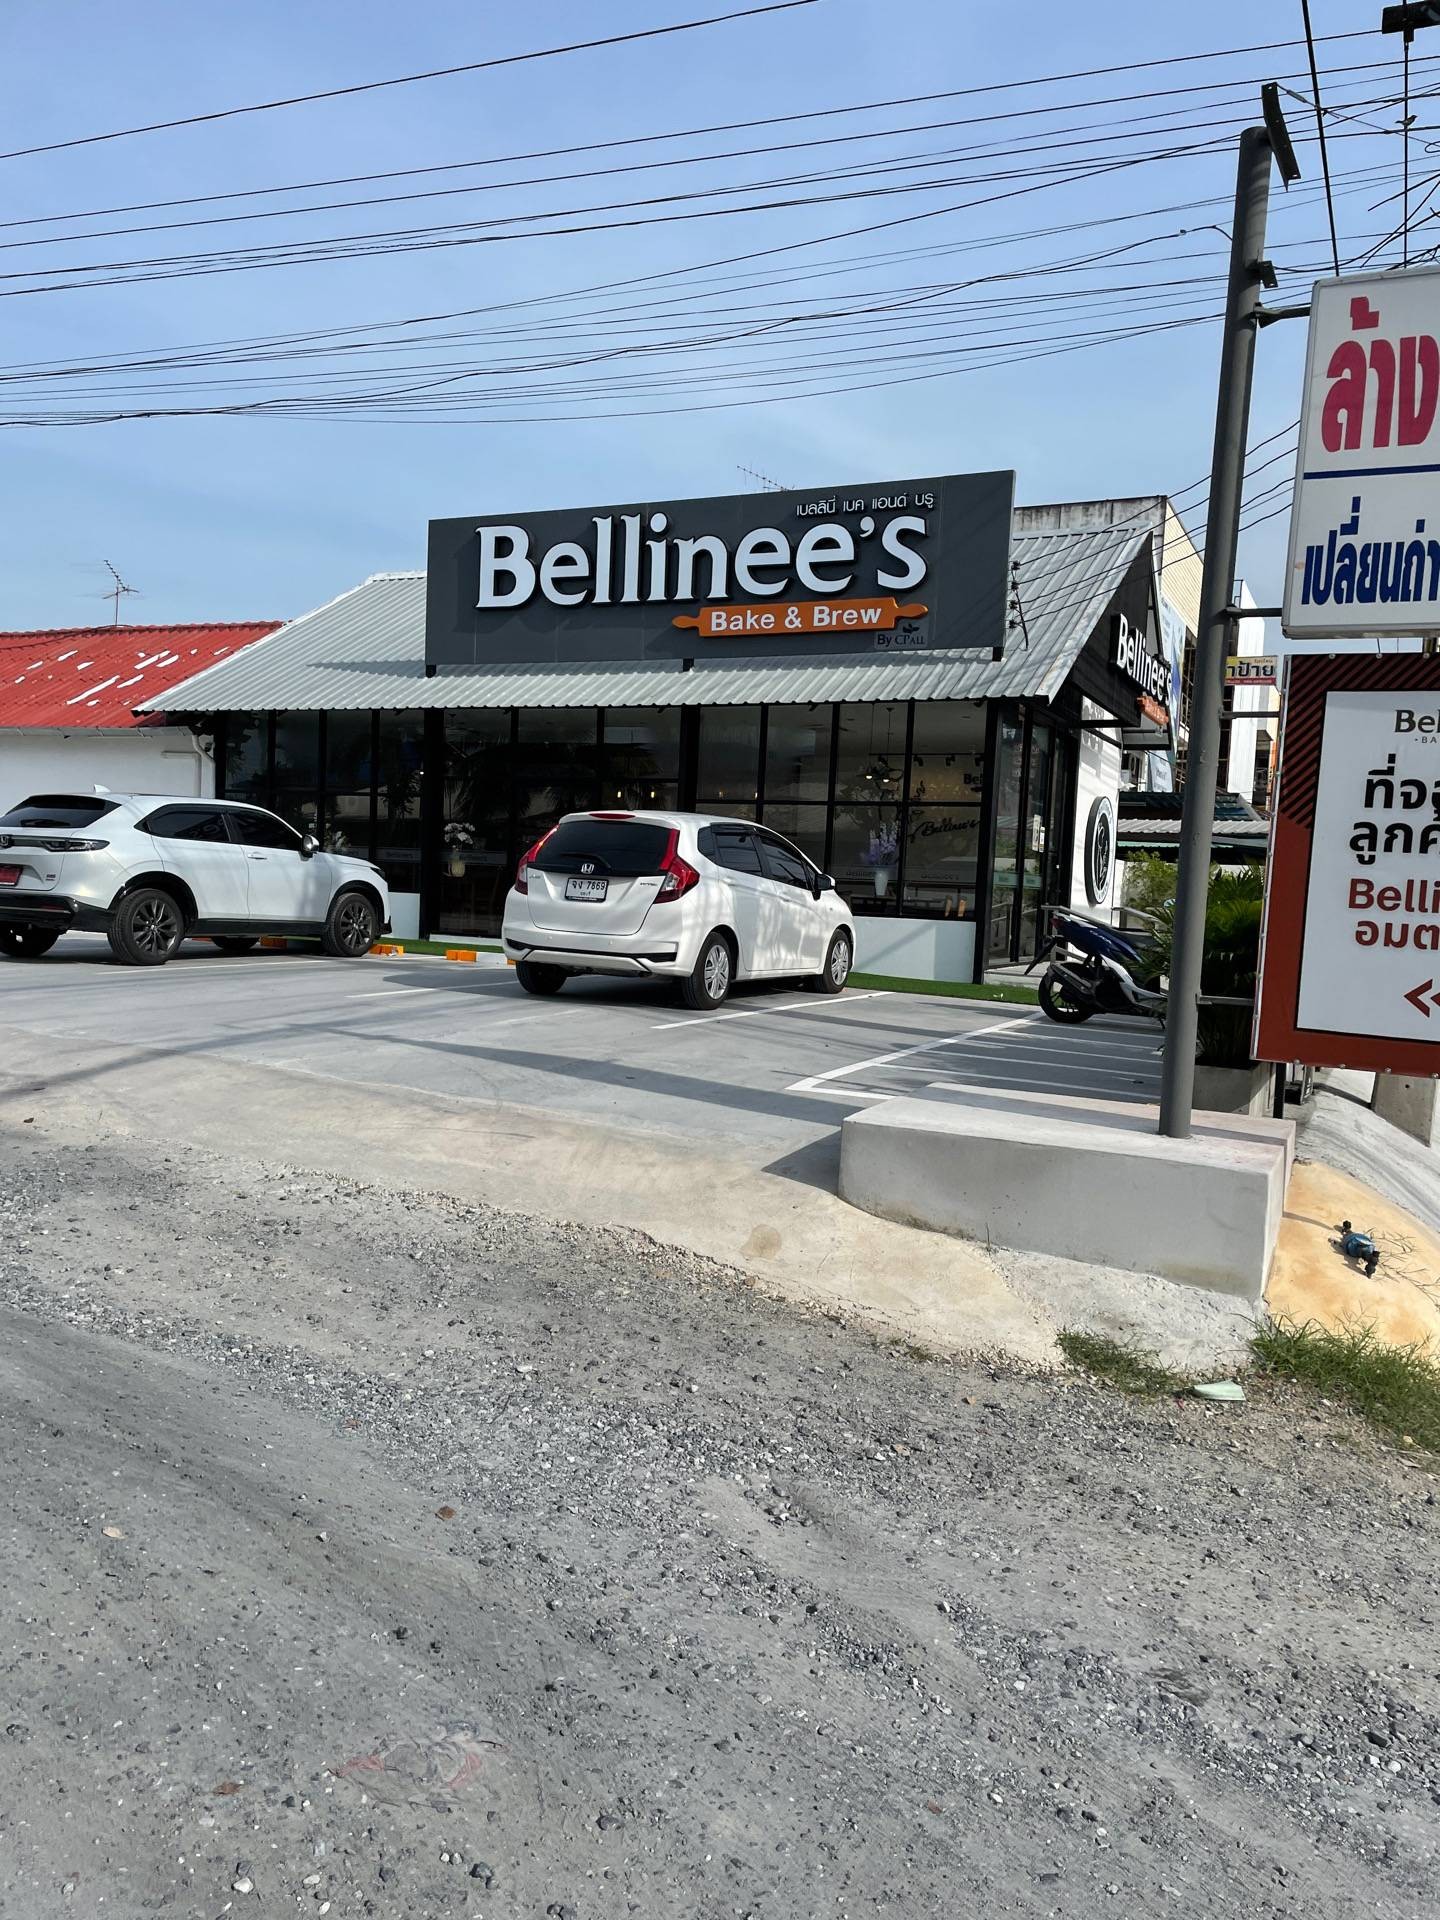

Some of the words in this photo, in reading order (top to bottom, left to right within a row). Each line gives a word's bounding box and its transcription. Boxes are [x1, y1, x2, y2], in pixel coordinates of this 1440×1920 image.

[1321, 296, 1440, 453] ล้าง
[475, 511, 929, 609] Bellinee's
[711, 609, 776, 631] Bake
[784, 605, 803, 628] &
[813, 605, 882, 627] Brew
[877, 633, 892, 648] By
[1116, 612, 1173, 706] Bellinee's
[1348, 878, 1440, 914] Belli
[1355, 920, 1440, 951] อมต
